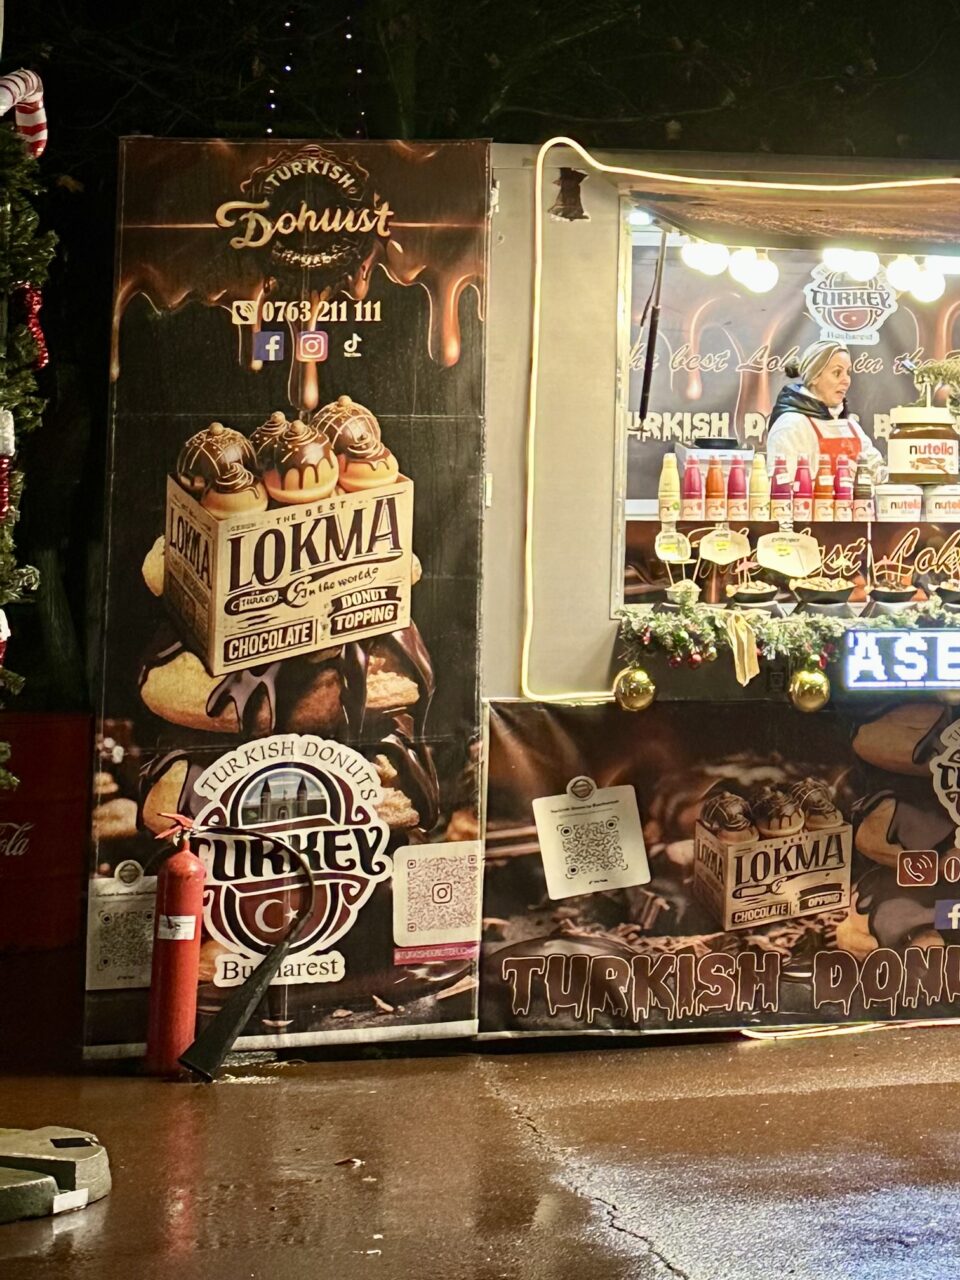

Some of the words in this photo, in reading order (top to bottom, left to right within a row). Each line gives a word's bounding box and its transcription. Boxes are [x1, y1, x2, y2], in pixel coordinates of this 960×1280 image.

[265, 159, 355, 188] TURKISH
[262, 300, 312, 322] 0763
[317, 300, 348, 322] 211
[354, 300, 382, 322] 111
[811, 288, 892, 308] TURKEY
[669, 343, 731, 372] best
[853, 352, 884, 374] in
[909, 442, 954, 455] nutella
[168, 507, 213, 591] LOKMA
[227, 496, 403, 593] LOKMA
[341, 588, 388, 610] DONUT
[336, 605, 394, 632] TOPPING
[227, 622, 311, 660] CHOCOLATE
[201, 740, 295, 793] TURKISH
[303, 741, 378, 801] DONUTS
[0, 821, 35, 857] ola
[733, 834, 846, 886] LOKMA
[733, 903, 788, 923] CHOCOLATE
[502, 951, 780, 1023] TURKISH
